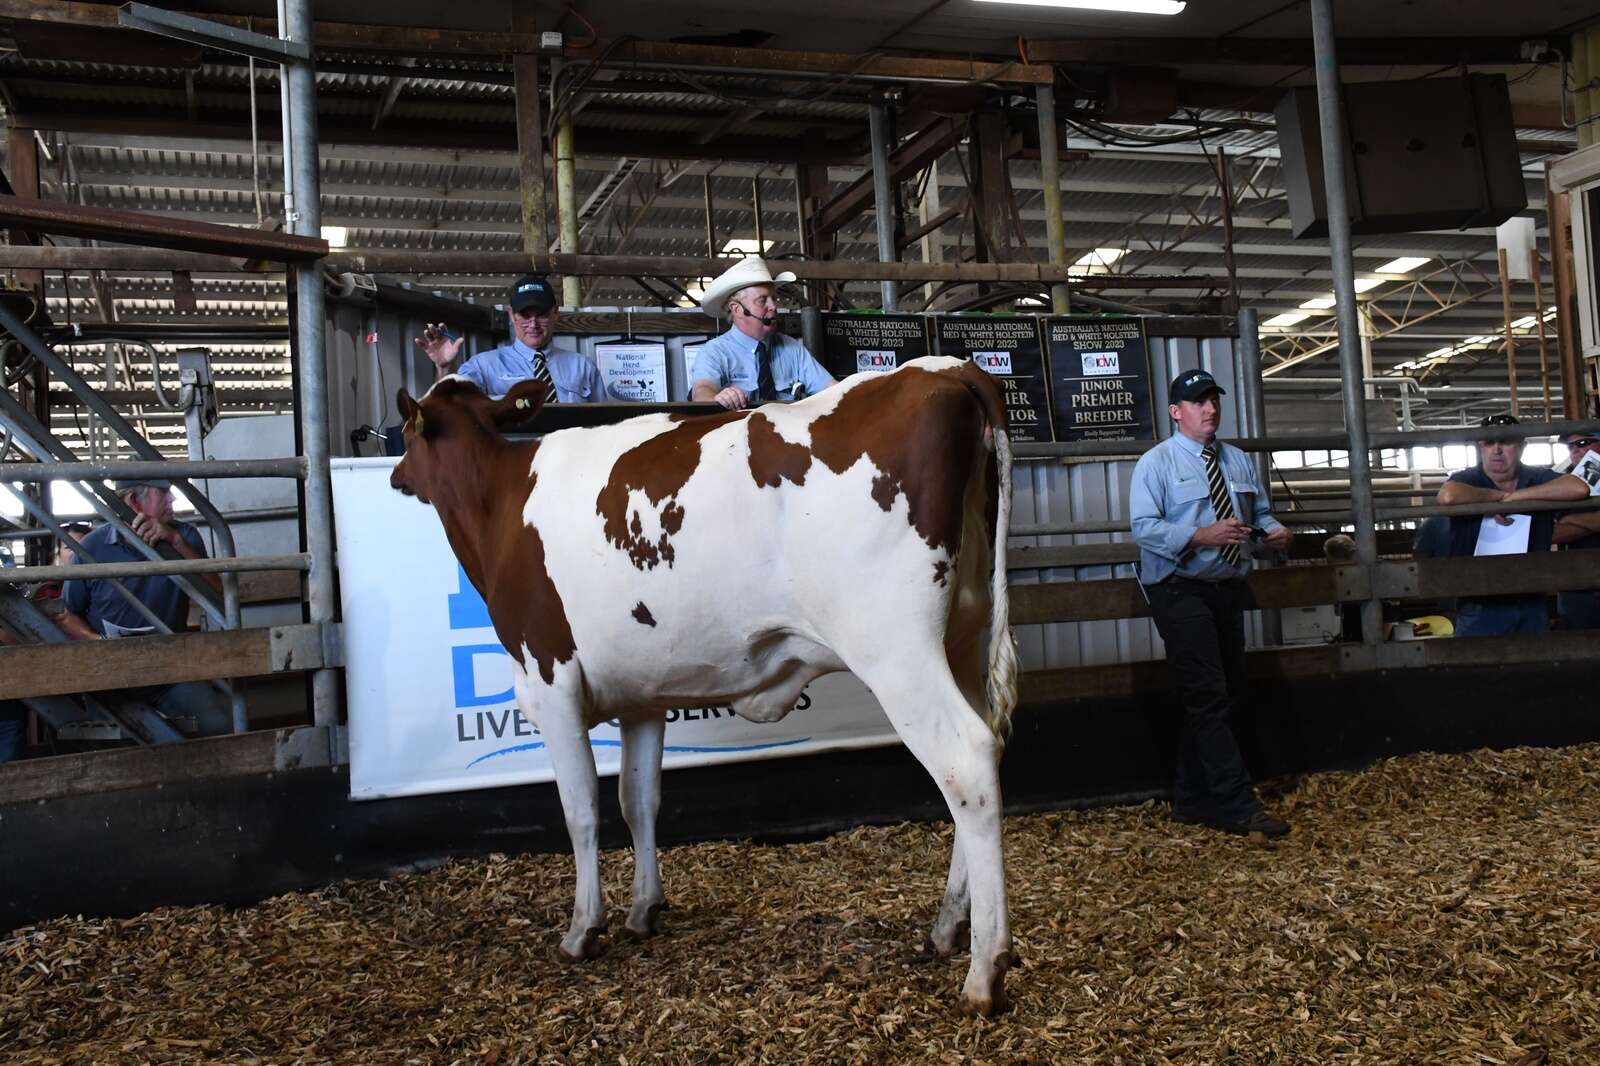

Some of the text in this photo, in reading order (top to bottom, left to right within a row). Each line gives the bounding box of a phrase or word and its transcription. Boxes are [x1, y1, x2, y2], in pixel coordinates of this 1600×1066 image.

[827, 320, 920, 330] AUSTRALIA'S NATIONAL
[1101, 323, 1138, 332] NATIONAL
[853, 329, 880, 337] WHITE
[1104, 331, 1139, 339] HOLSTEIN
[849, 338, 904, 347] SHOW 2023
[965, 339, 1017, 348] SHOW 2023
[1073, 340, 1124, 350] SHOW 2023
[1080, 380, 1124, 392] JUNIOR
[1072, 392, 1134, 407] PREMIER
[1008, 409, 1038, 420] TOR
[1075, 410, 1133, 423] BREEDER
